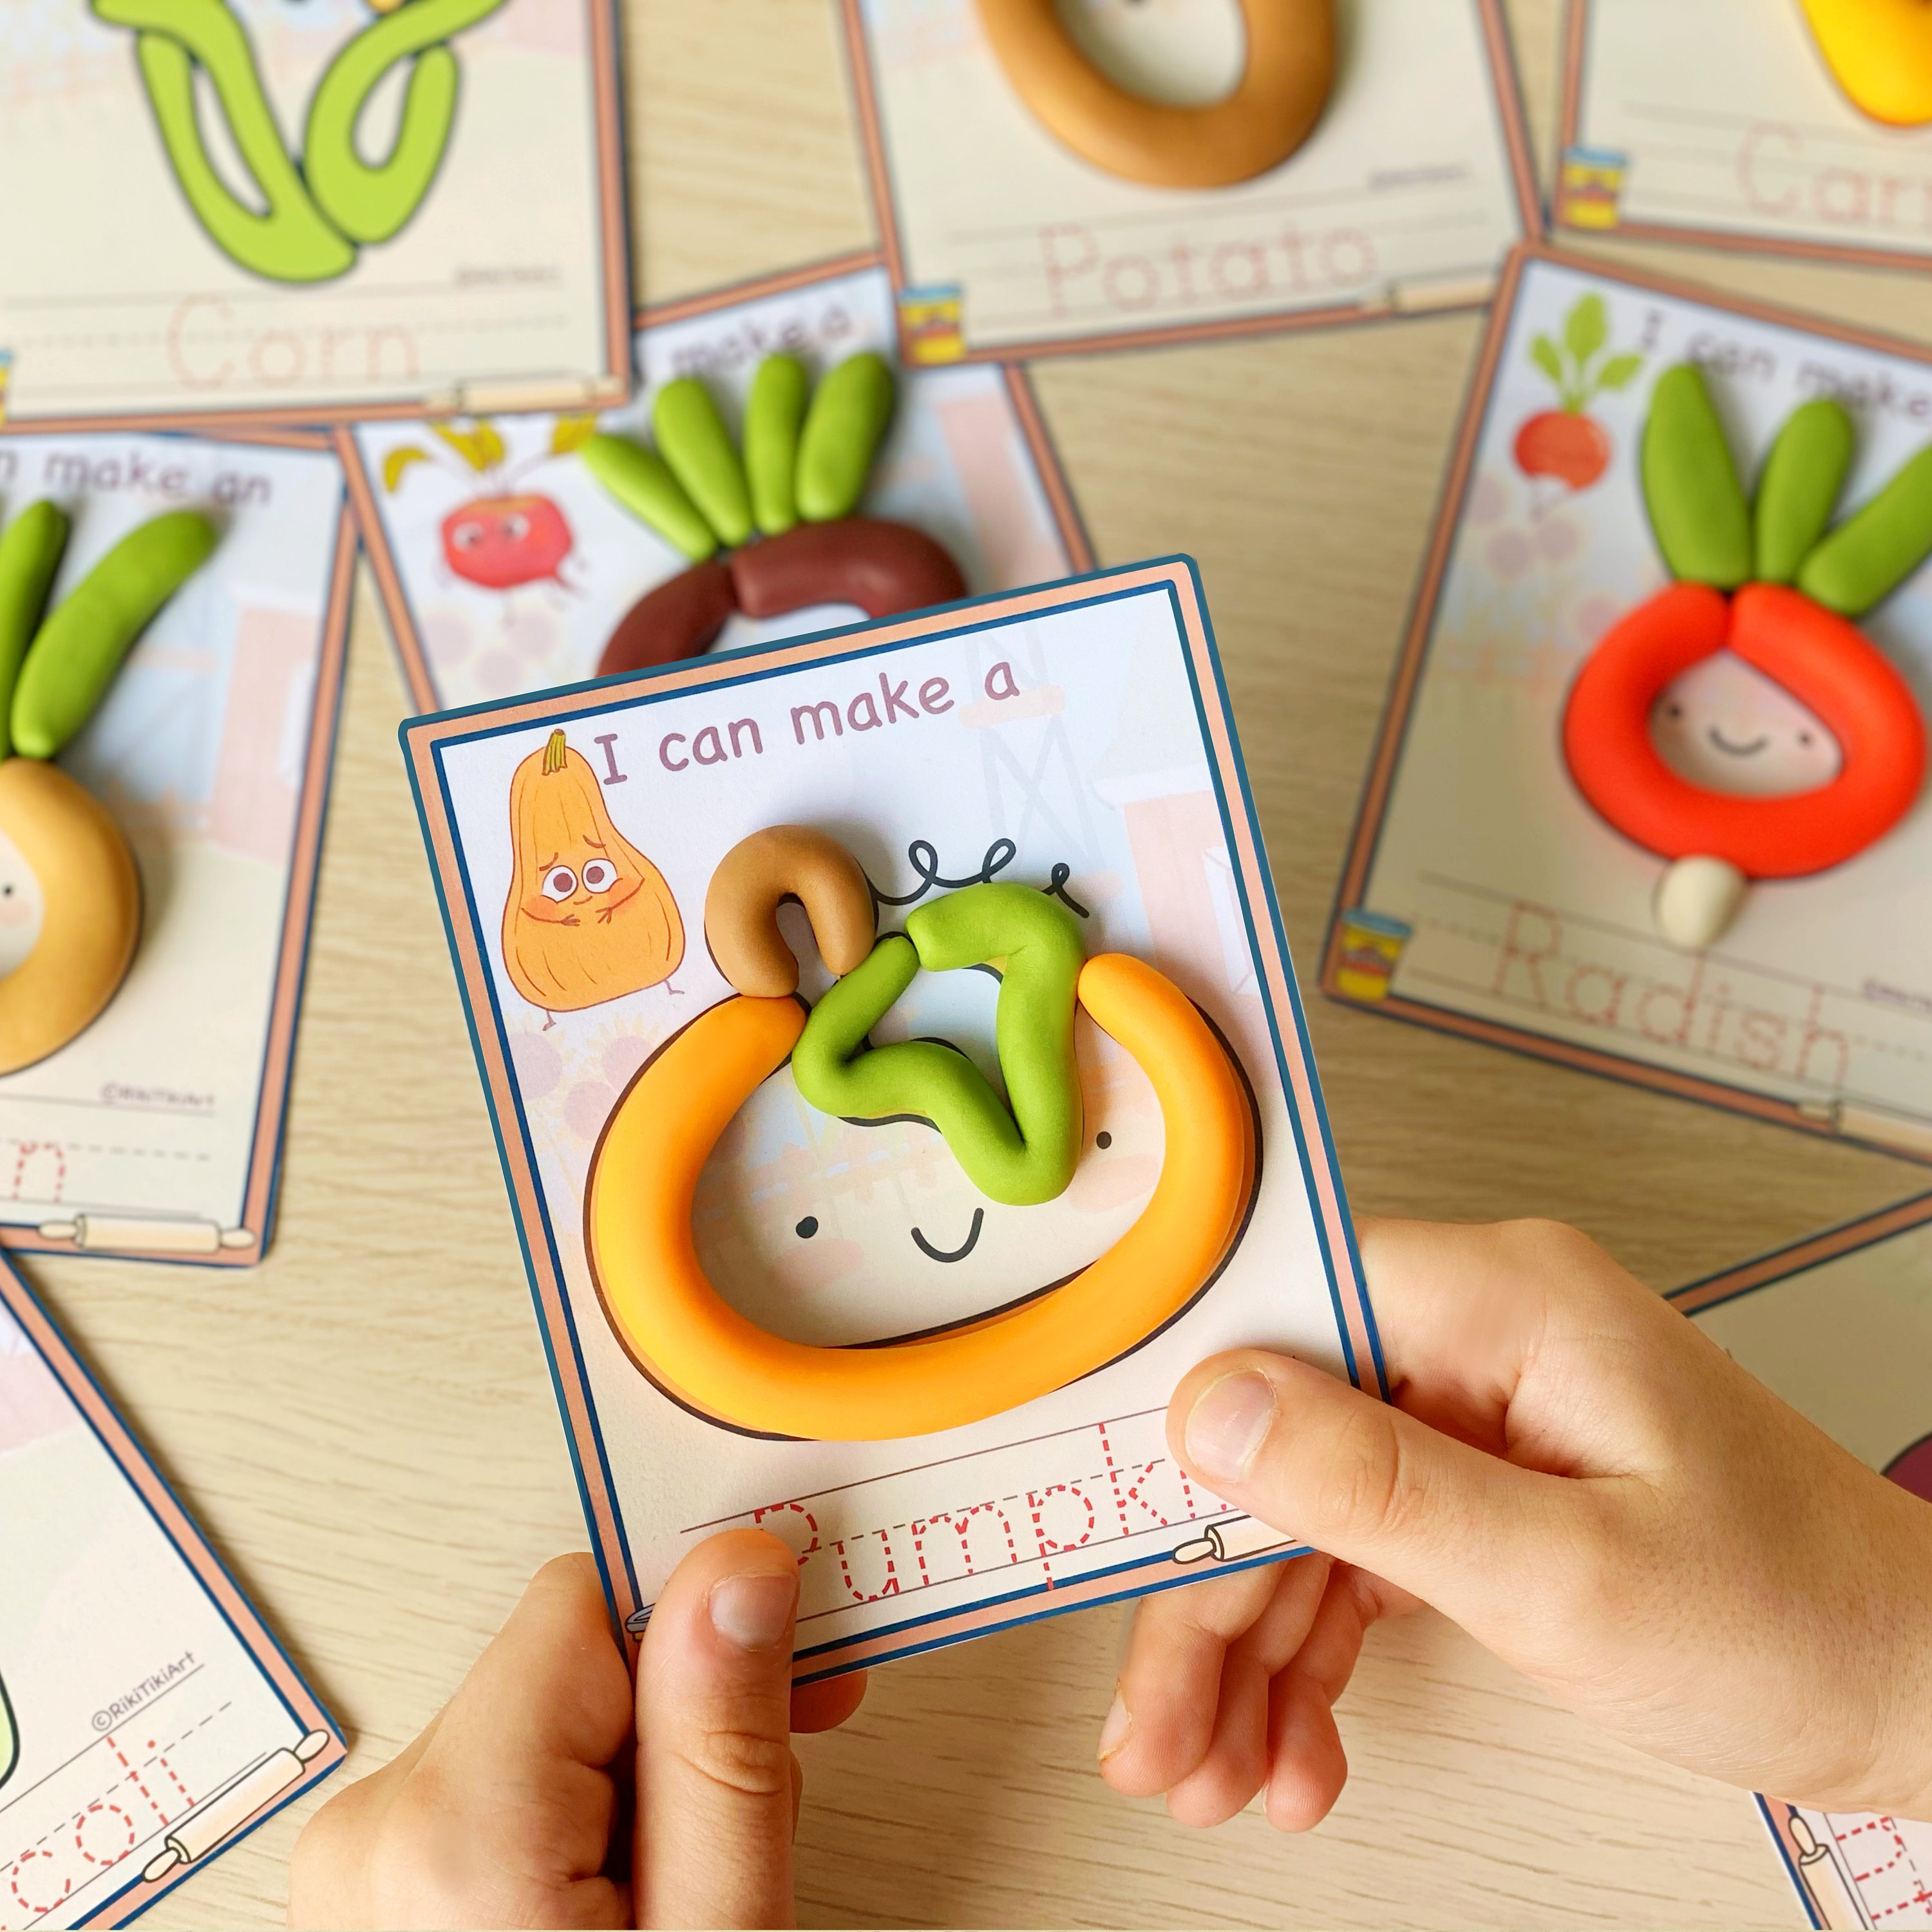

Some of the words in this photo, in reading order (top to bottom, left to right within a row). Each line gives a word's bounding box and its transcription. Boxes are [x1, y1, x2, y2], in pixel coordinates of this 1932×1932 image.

[1734, 120, 1932, 228] Car
[1037, 220, 1379, 318] Potato
[166, 292, 420, 390] Corn
[43, 450, 189, 498] make
[210, 469, 273, 506] an
[594, 733, 628, 786] I
[658, 717, 763, 772] can
[790, 672, 954, 745] make
[984, 661, 1020, 701] a
[1490, 898, 1851, 1096] Radish
[755, 1422, 1228, 1602] Pumpki
[1, 1736, 195, 1931] coli
